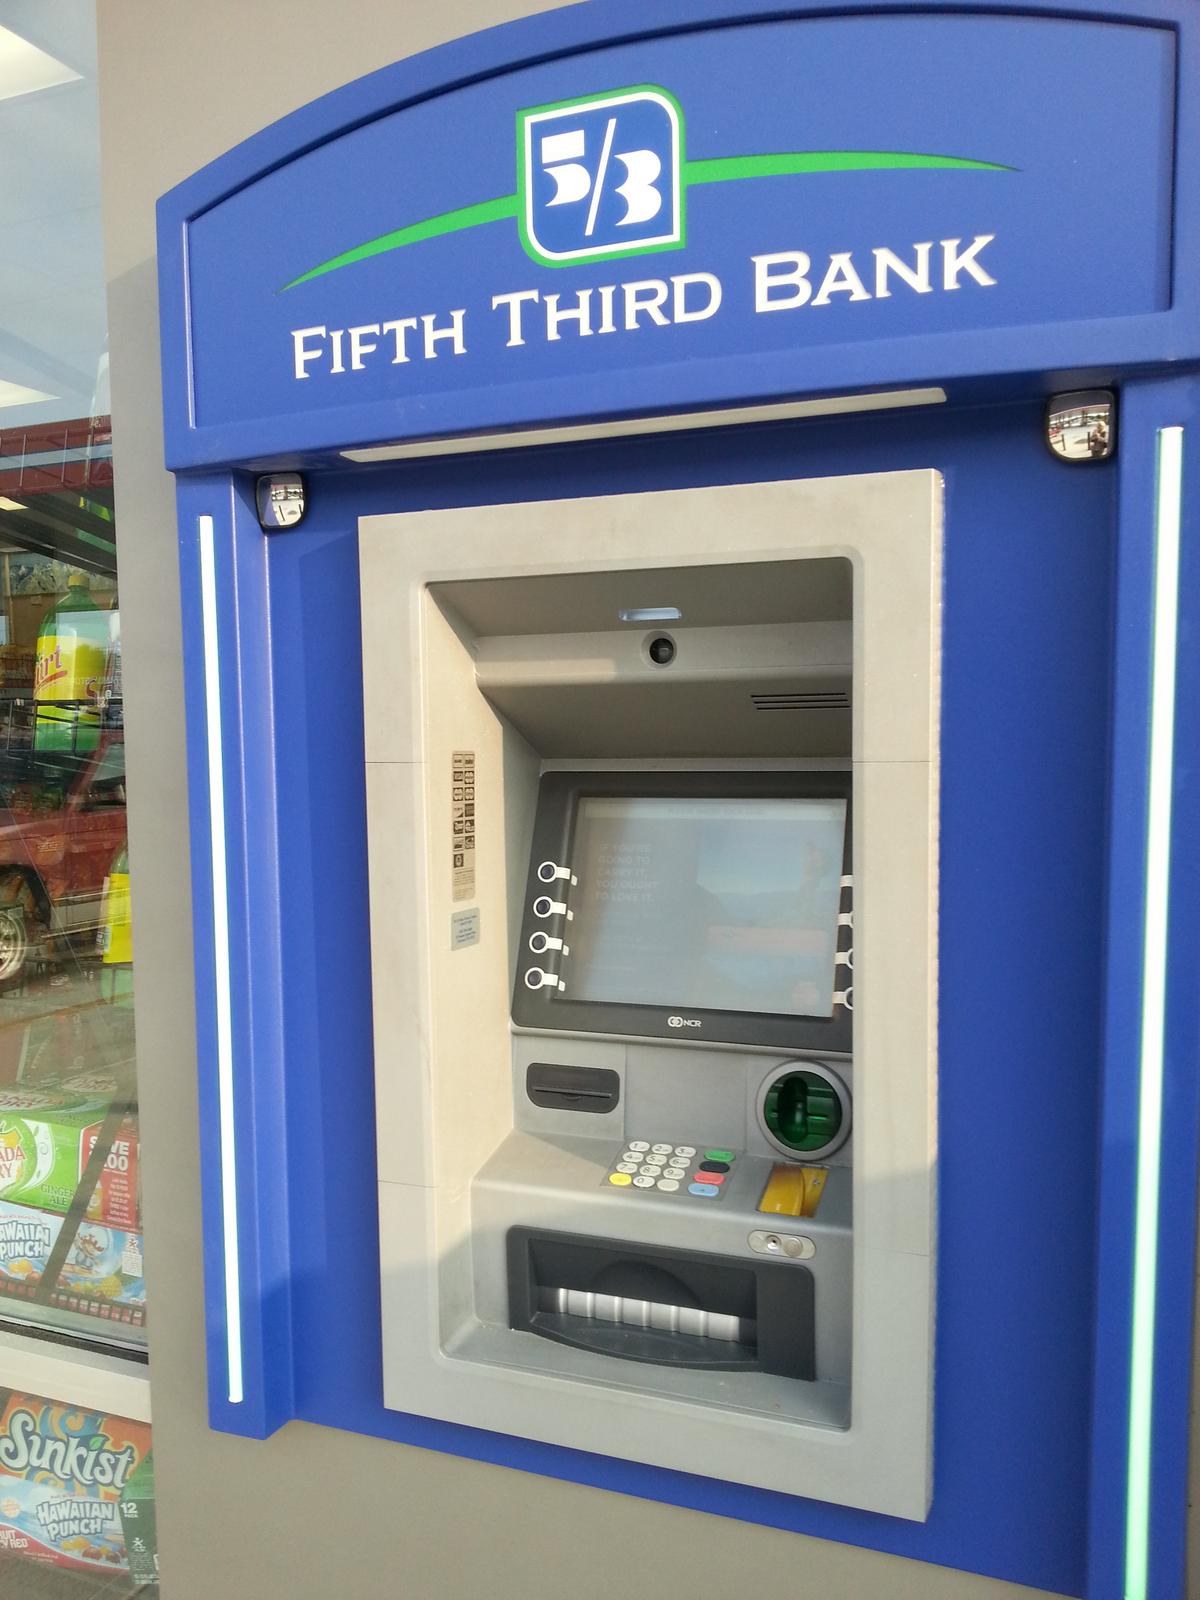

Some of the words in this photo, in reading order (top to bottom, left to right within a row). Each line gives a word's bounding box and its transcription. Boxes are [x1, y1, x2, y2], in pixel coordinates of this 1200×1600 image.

[541, 117, 663, 237] 5/3
[290, 308, 468, 380] FIFTH
[491, 271, 723, 349] THIRD
[750, 233, 998, 314] BANK
[683, 1019, 702, 1028] NCR
[0, 1412, 133, 1488] Sunkist
[37, 1500, 115, 1526] HAWAIIAN
[120, 1502, 138, 1514] 12
[48, 1519, 103, 1541] PUNCH
